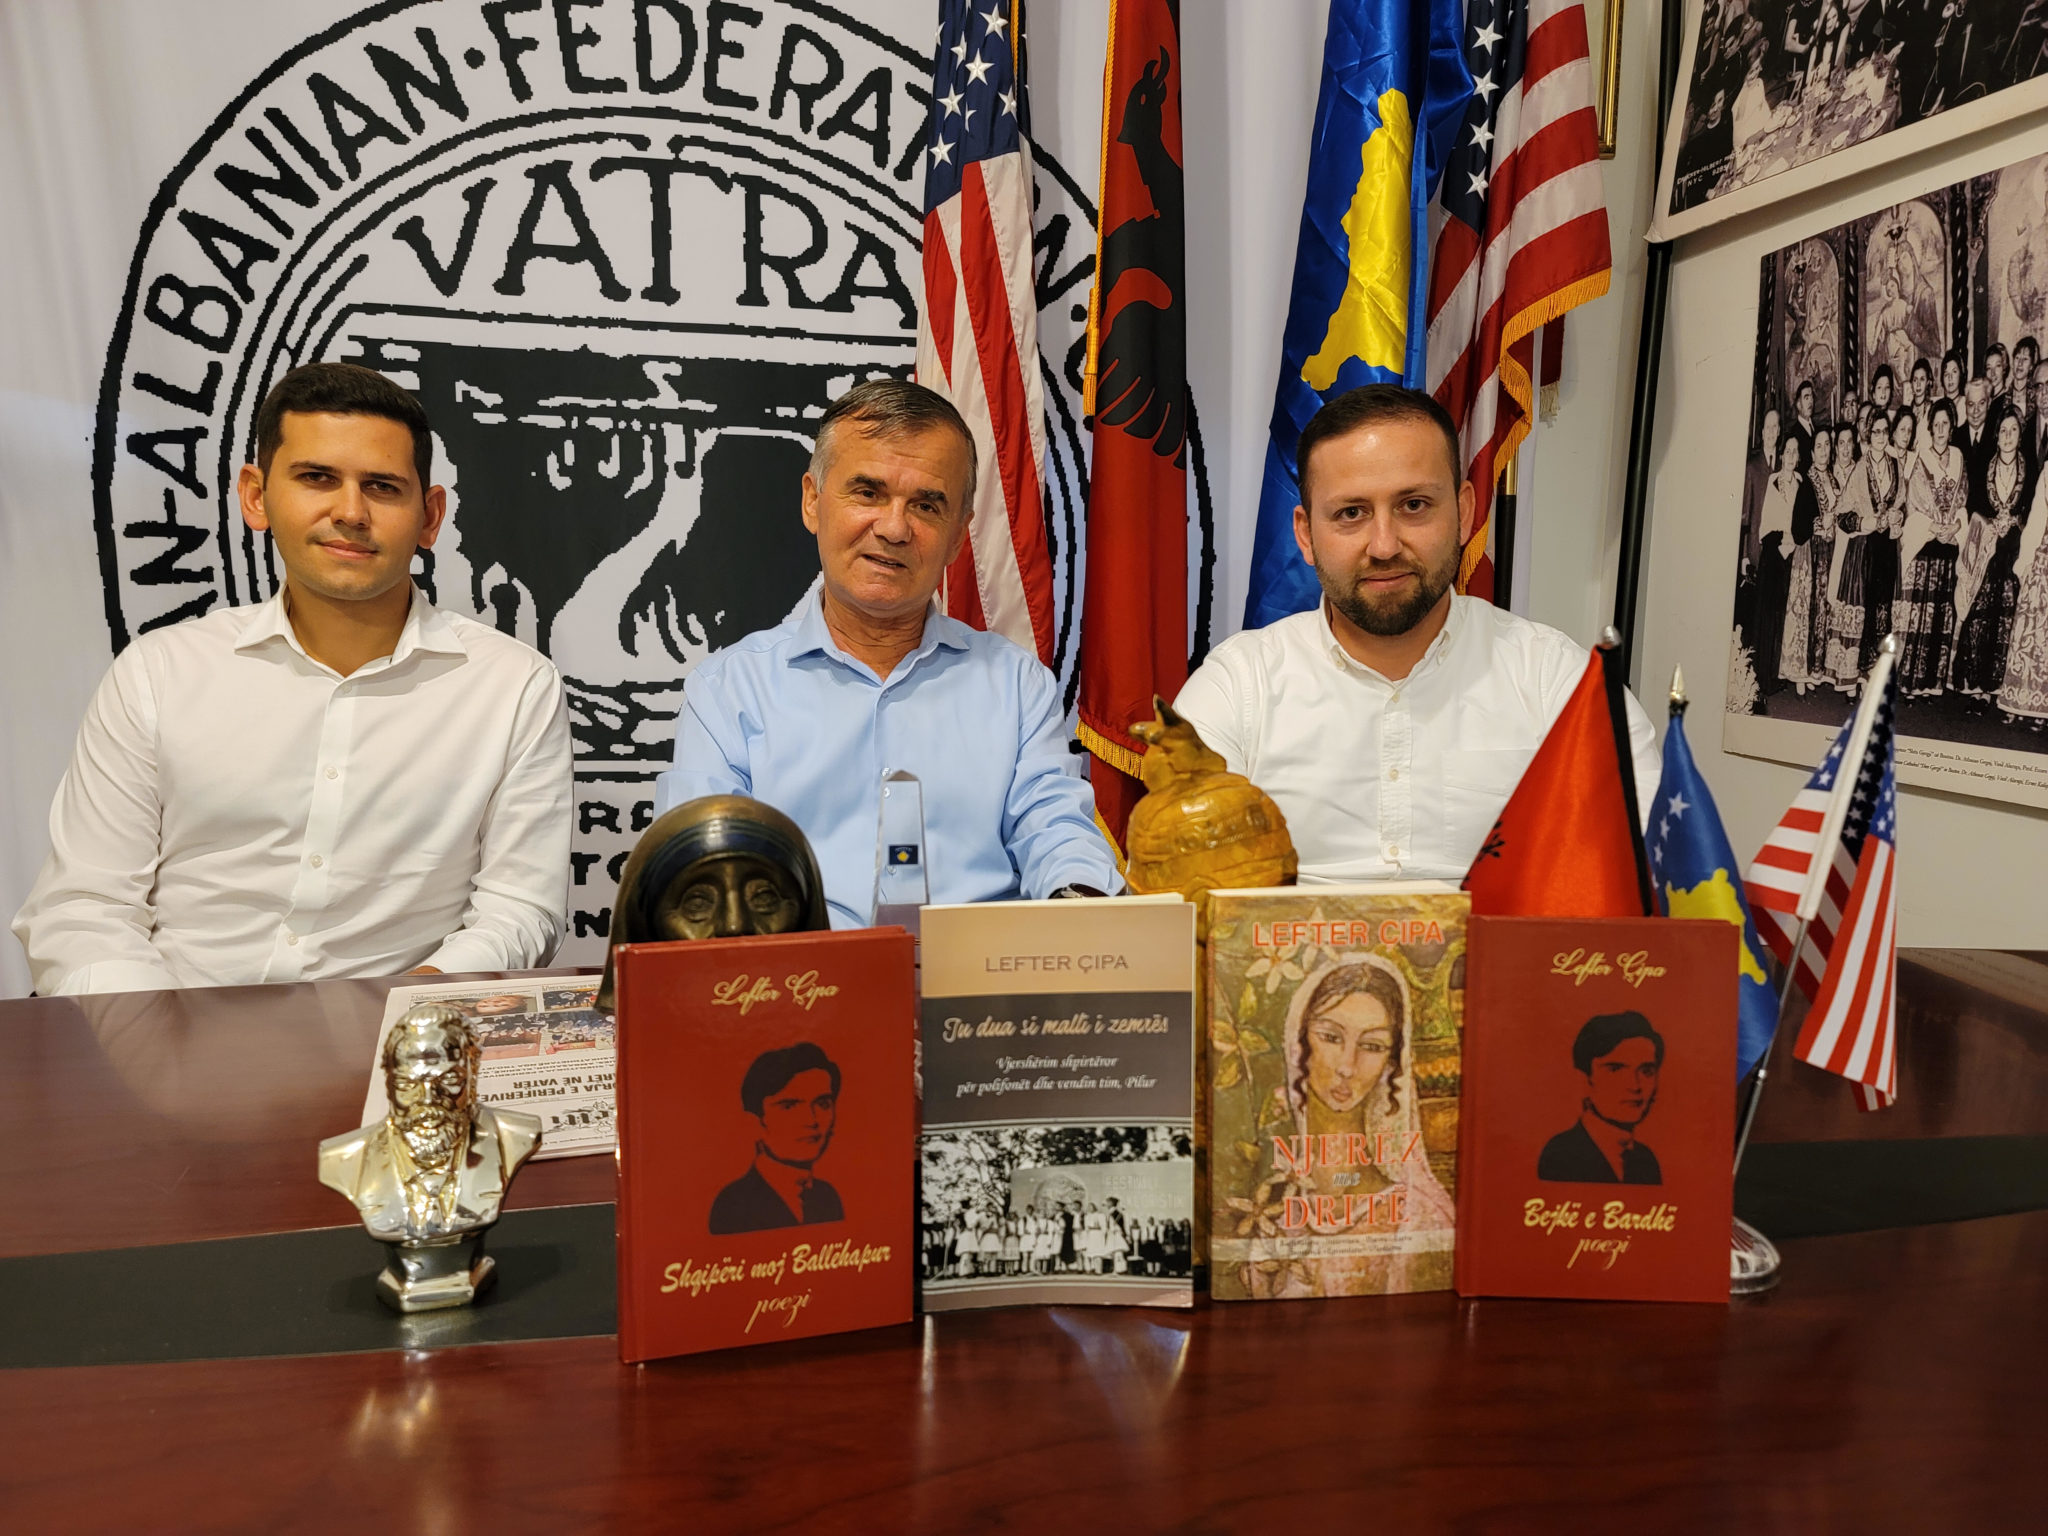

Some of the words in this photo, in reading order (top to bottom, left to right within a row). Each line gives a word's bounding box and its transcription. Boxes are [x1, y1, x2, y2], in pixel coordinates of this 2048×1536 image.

[392, 156, 917, 329] VATRA
[1252, 920, 1369, 949] LEFTER
[1378, 918, 1445, 952] ÇIPA
[985, 954, 1071, 972] LEFTER
[1077, 954, 1128, 974] ÇIPA
[1550, 947, 1614, 987] Lefter
[711, 973, 782, 1016] Lefter
[975, 1015, 1017, 1038] dua
[1020, 1016, 1040, 1036] si
[1094, 1014, 1106, 1035] i
[513, 1078, 558, 1090] VATËR
[562, 1076, 582, 1087] NË
[570, 1086, 578, 1094] E
[1271, 1129, 1423, 1177] NJERËZ
[1282, 1185, 1410, 1230] DRITË
[1524, 1198, 1582, 1236] Bejkë
[1584, 1211, 1597, 1229] e
[1603, 1200, 1678, 1232] Bardhë
[1566, 1235, 1632, 1270] poezi
[660, 1257, 746, 1298] Shqipëri
[750, 1252, 787, 1285] moj
[744, 1288, 812, 1334] poezi
